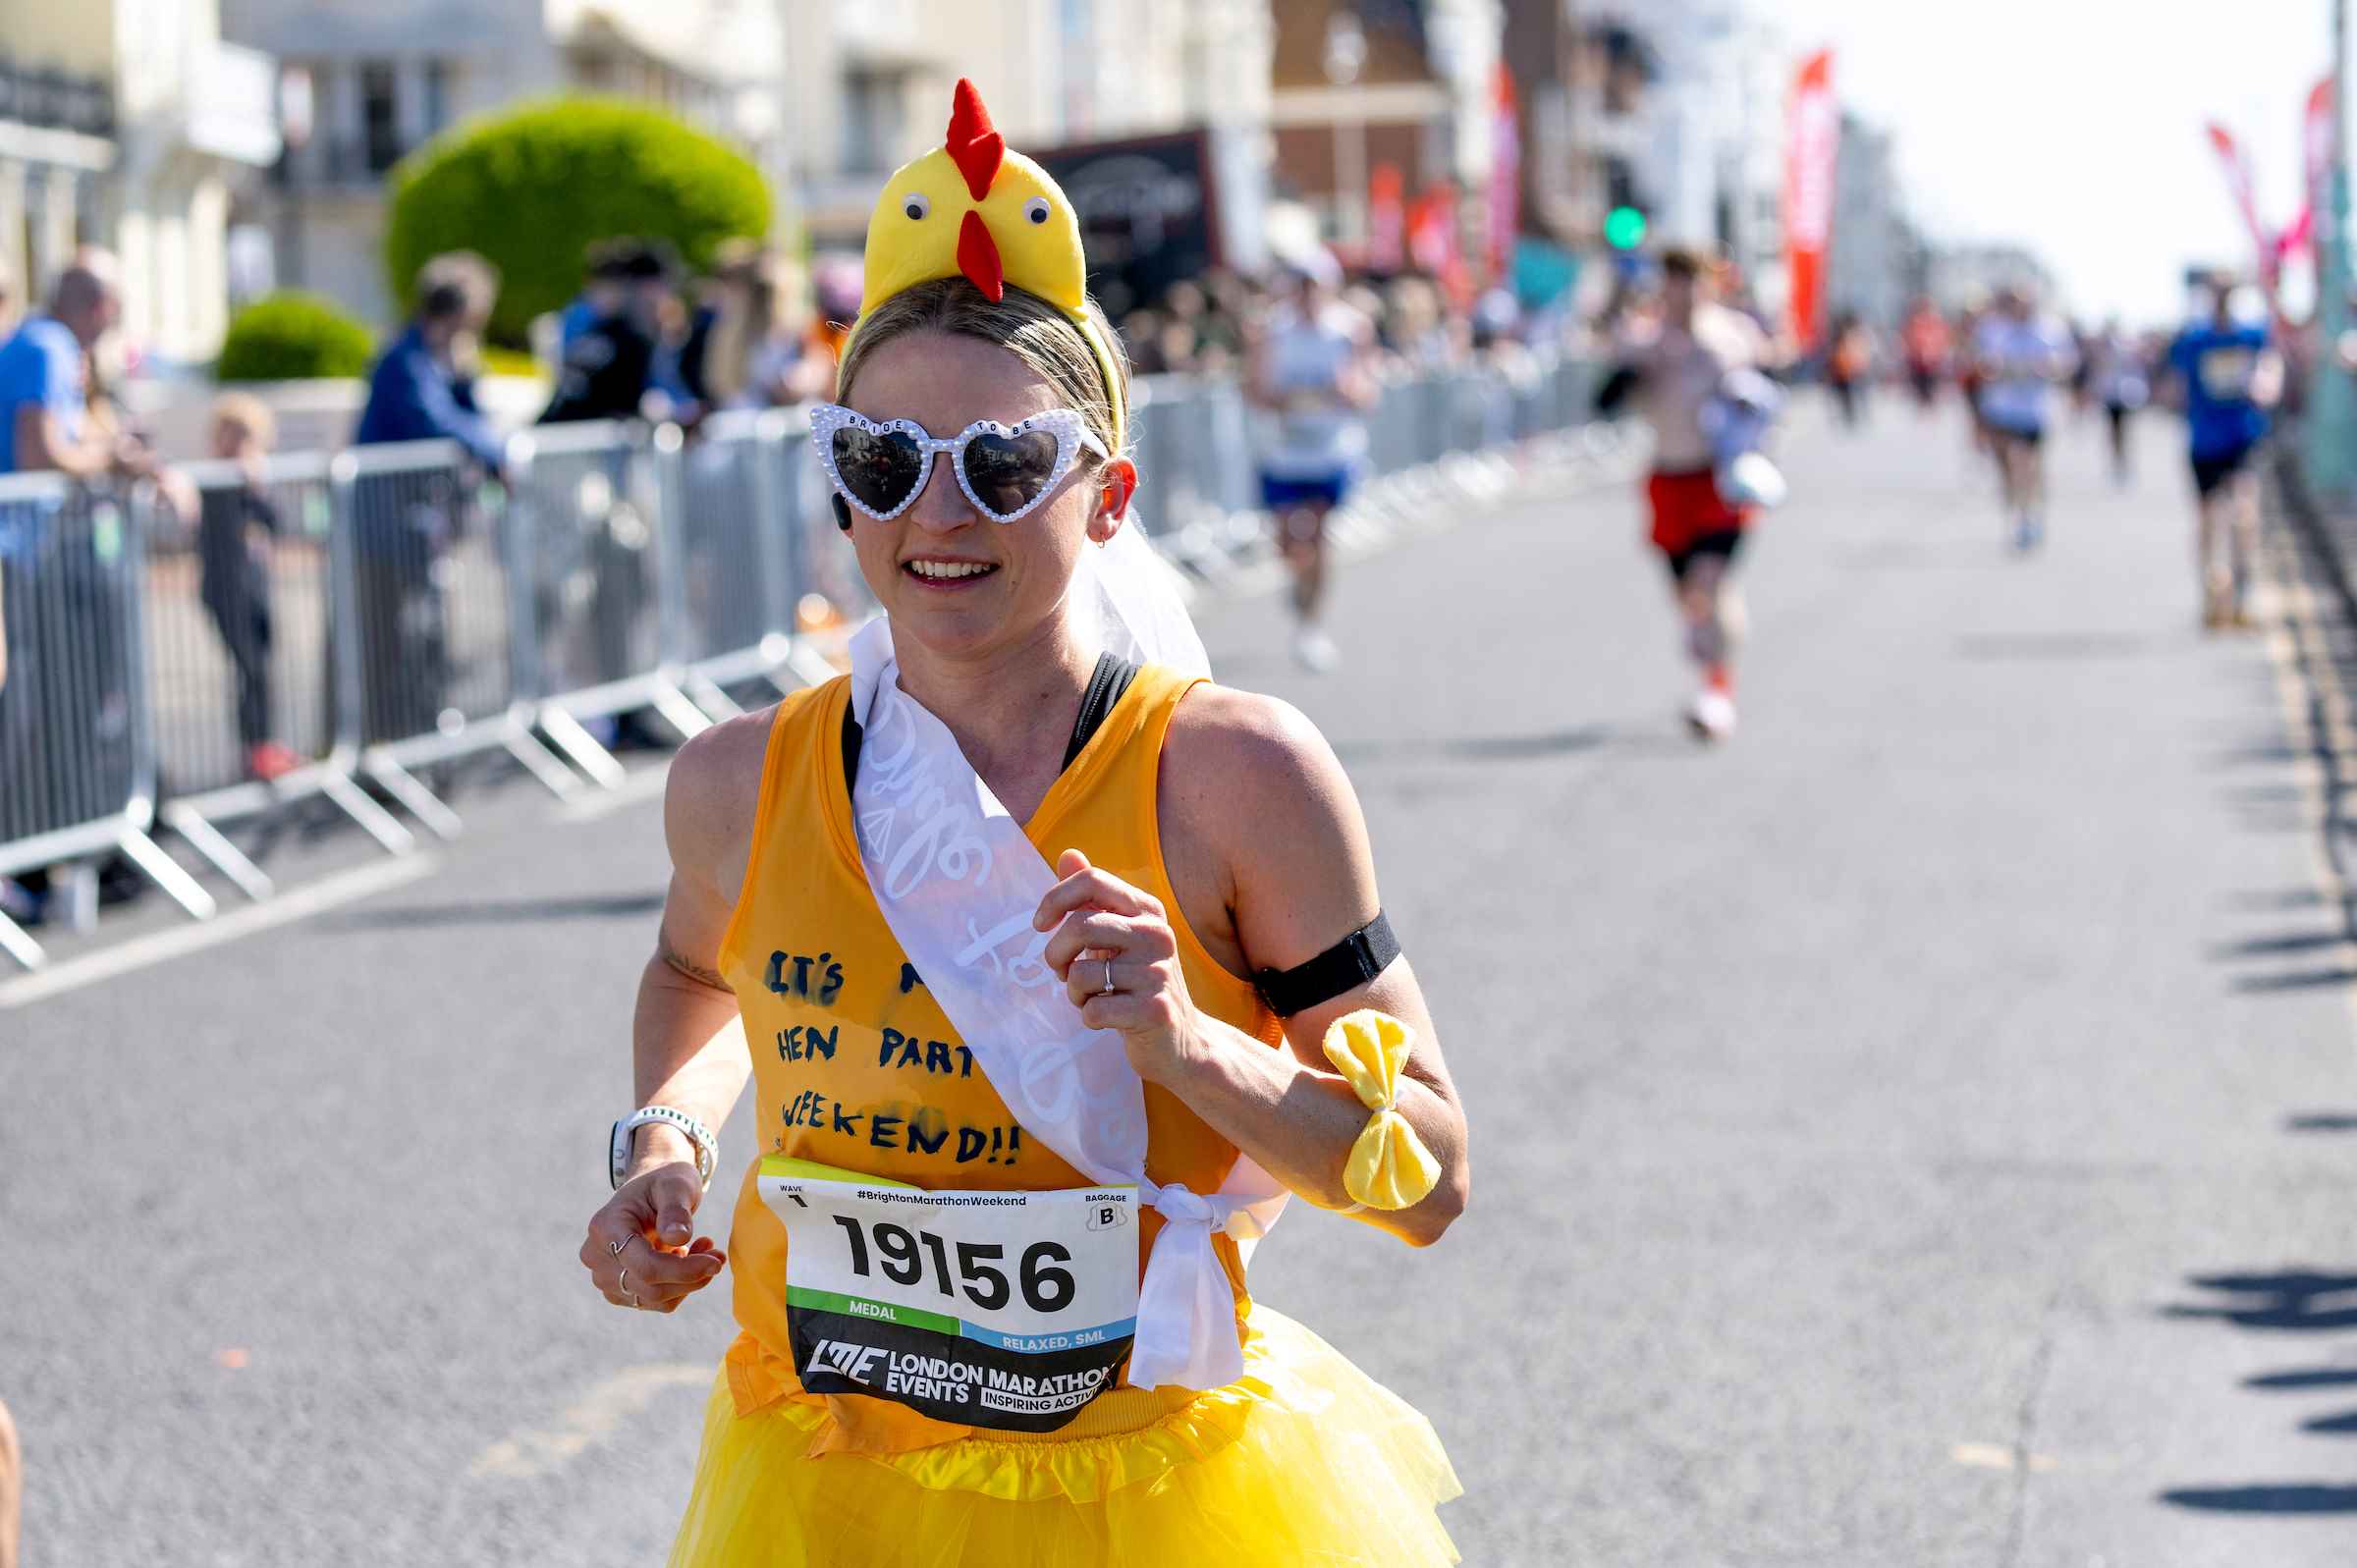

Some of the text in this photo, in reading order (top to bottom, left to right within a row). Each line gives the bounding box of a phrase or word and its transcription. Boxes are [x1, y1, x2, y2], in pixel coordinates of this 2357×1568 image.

[849, 415, 1032, 435] BRIDE TO BE
[777, 1025, 973, 1078] HEN PART
[782, 1090, 1021, 1165] WEEKEND!!
[856, 1189, 1027, 1208] #BrightonMarathonWeekend
[1085, 1194, 1127, 1203] BAGGAGE
[1100, 1207, 1115, 1225] B
[832, 1214, 1076, 1314] 19156
[849, 1299, 898, 1322] MEDAL
[1002, 1329, 1106, 1351] RELAXED, SML
[888, 1350, 983, 1386] LONDON
[885, 1372, 969, 1404] EVENTS
[985, 1391, 1052, 1411] INSPIRING
